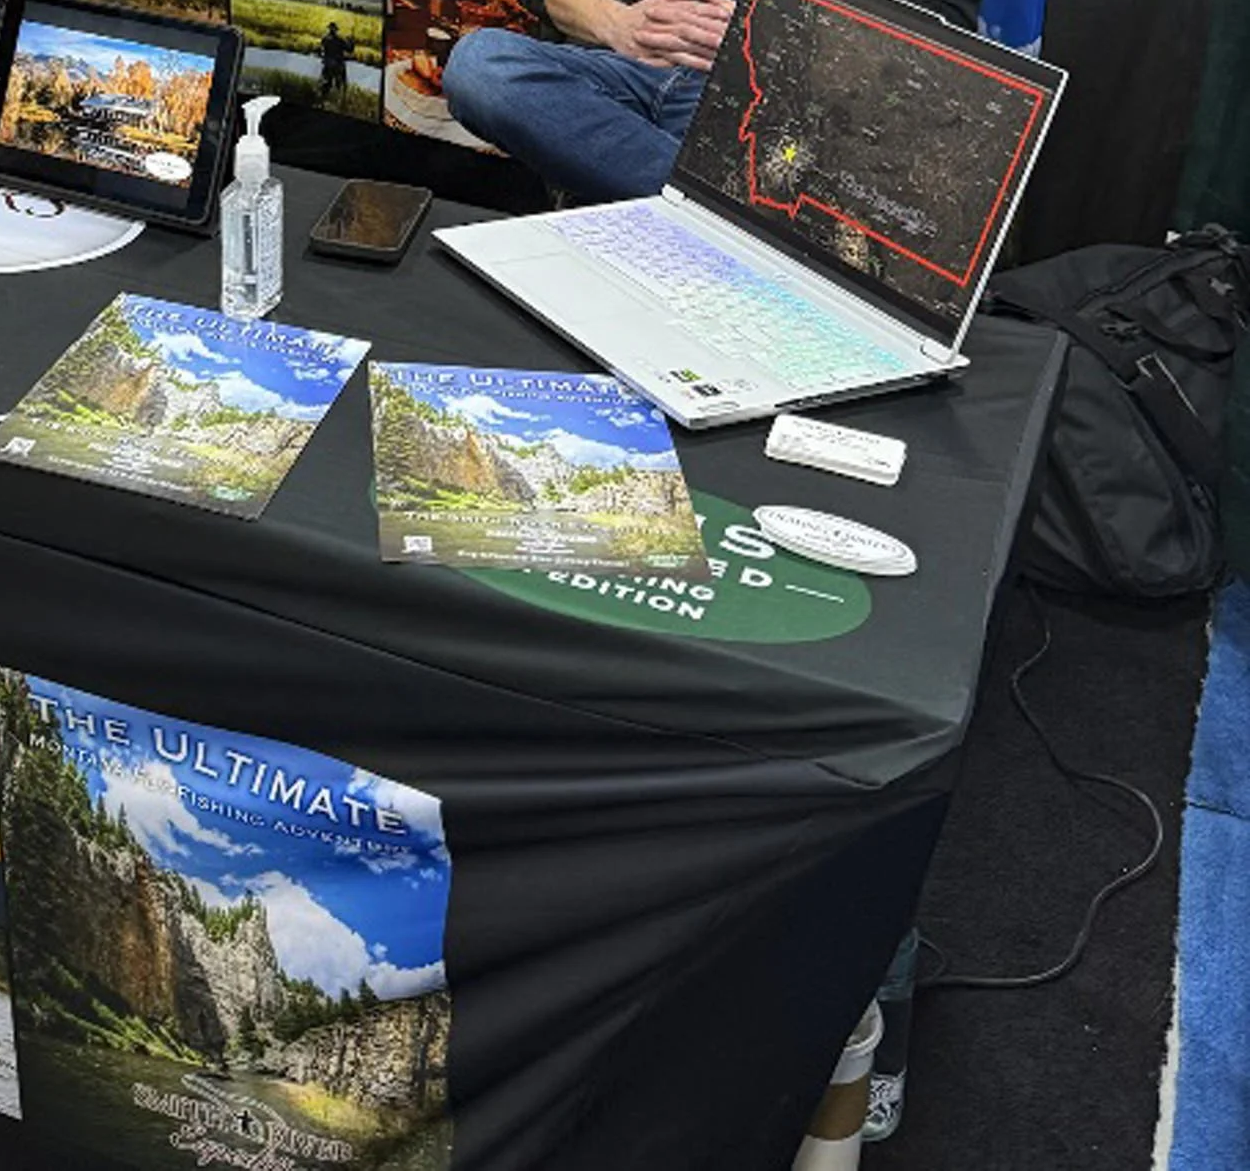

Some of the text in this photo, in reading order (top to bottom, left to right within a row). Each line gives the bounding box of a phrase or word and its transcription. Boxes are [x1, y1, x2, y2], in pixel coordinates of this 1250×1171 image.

[547, 570, 706, 621] EDITION
[27, 692, 131, 746] THE
[153, 725, 407, 836] ULTIMATE
